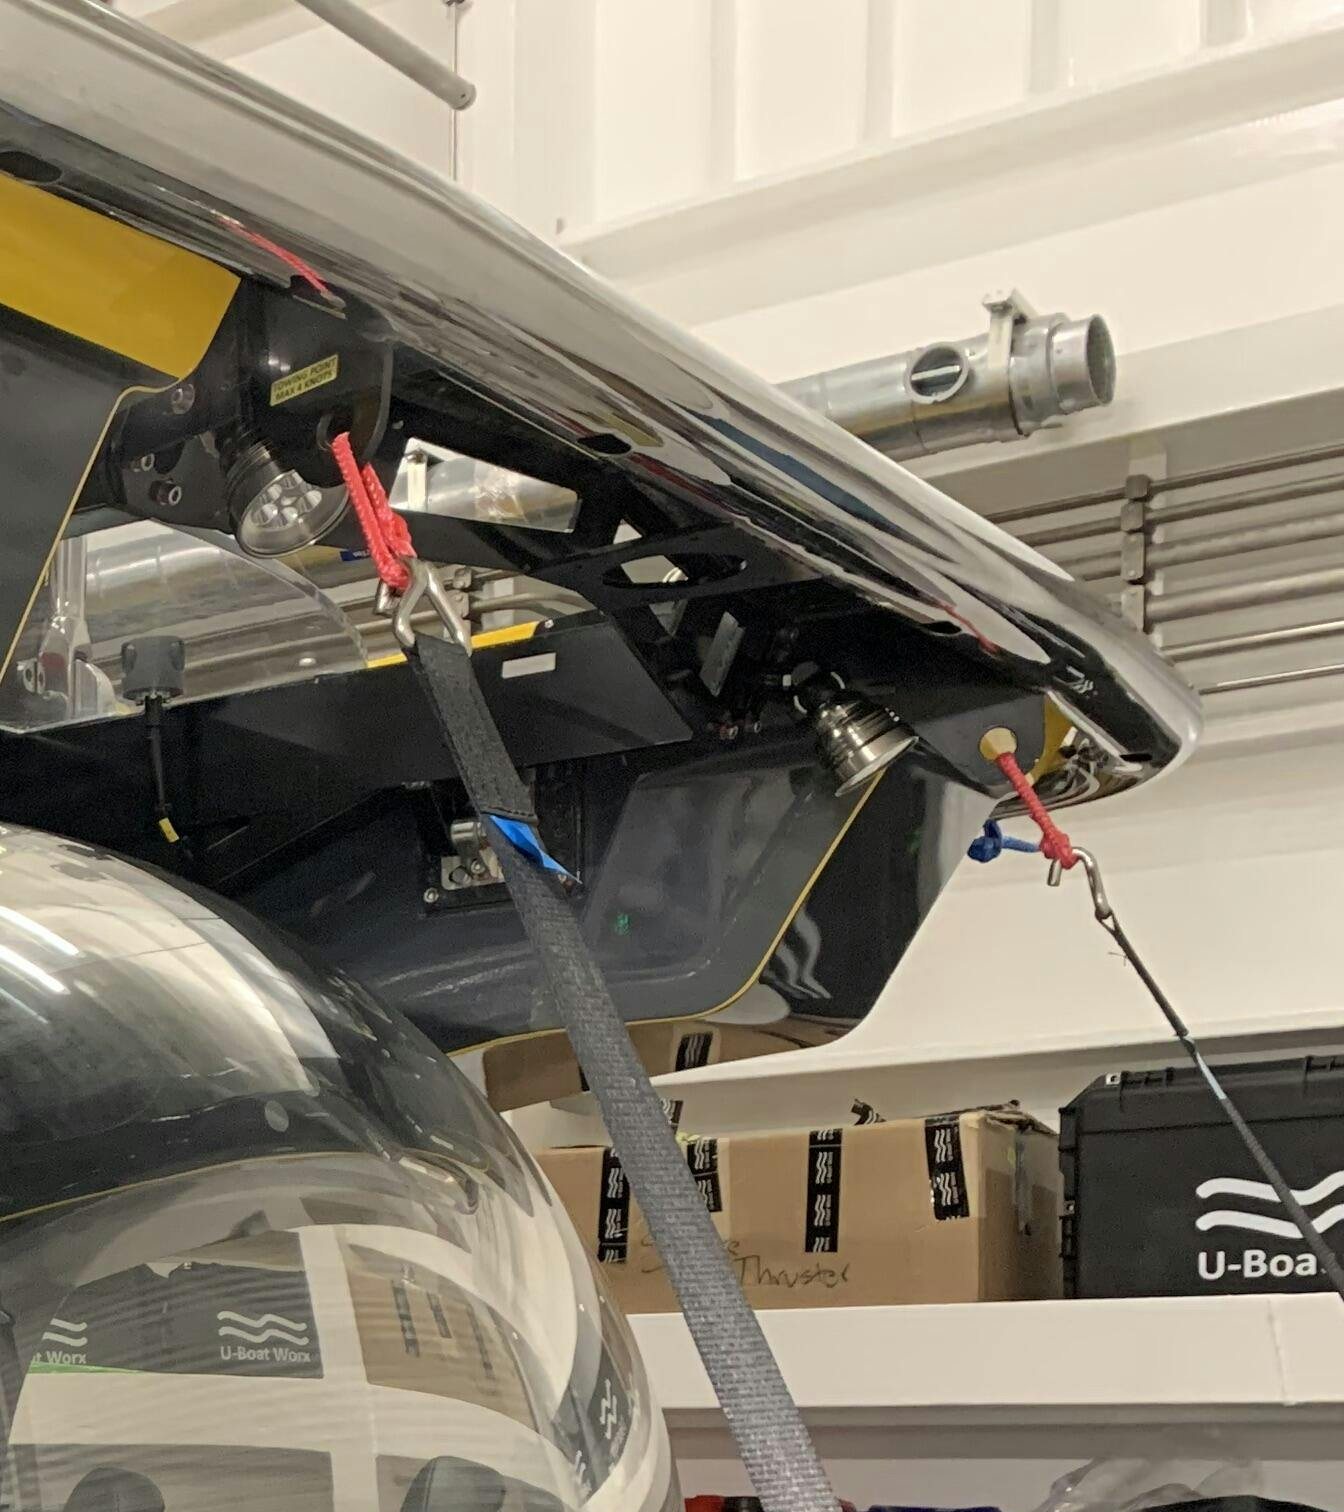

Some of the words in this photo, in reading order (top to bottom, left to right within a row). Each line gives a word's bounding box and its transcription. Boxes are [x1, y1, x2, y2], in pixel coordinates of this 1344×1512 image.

[1198, 1249, 1327, 1280] U-Boa
[46, 1350, 87, 1365] Worx
[220, 1346, 270, 1361] U-Boat
[272, 1347, 312, 1362] Worx
